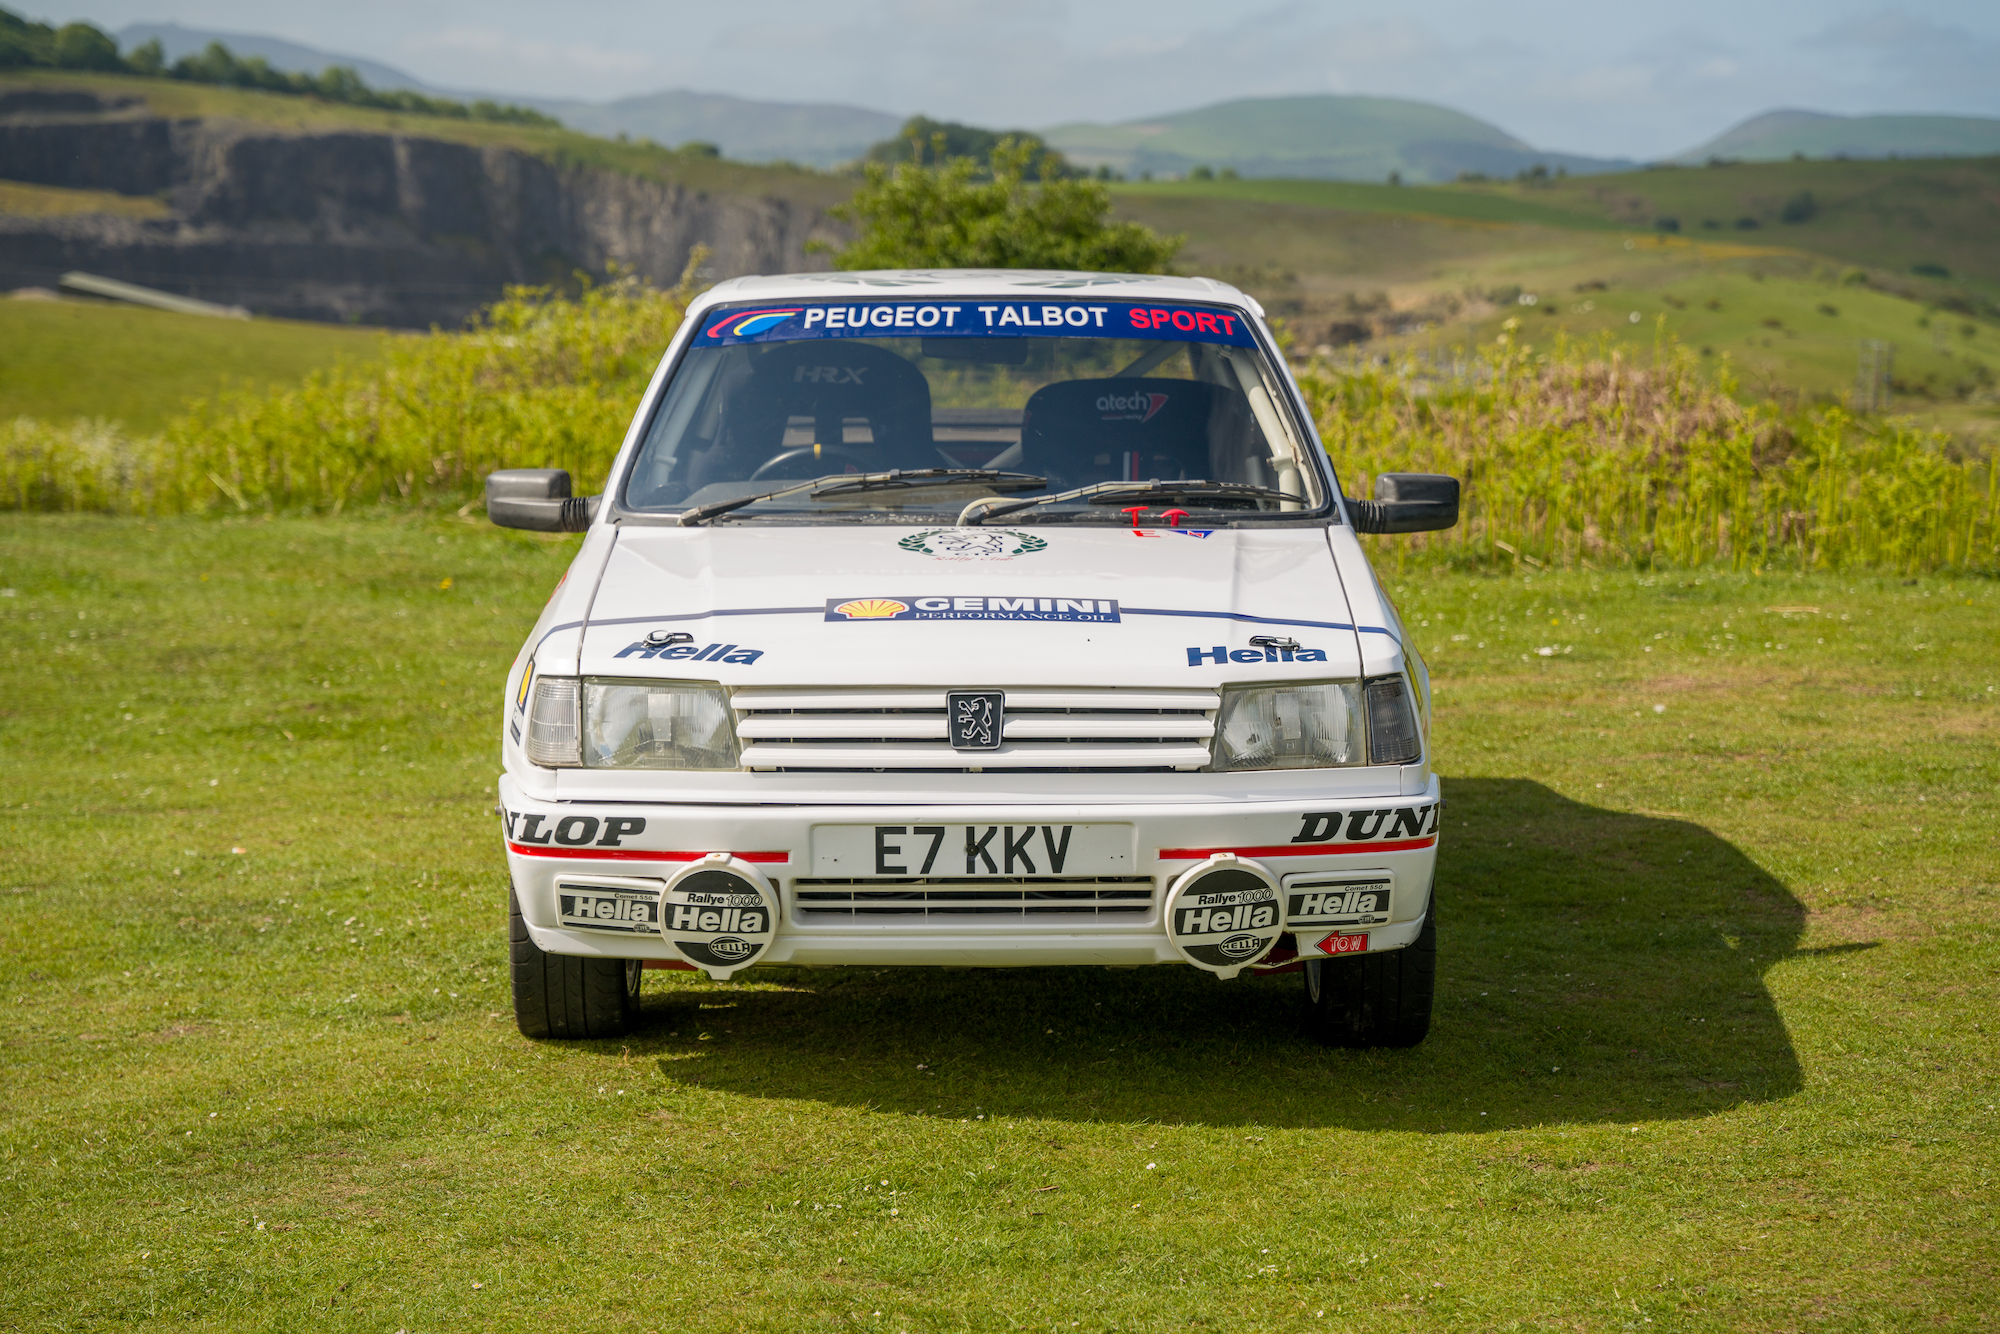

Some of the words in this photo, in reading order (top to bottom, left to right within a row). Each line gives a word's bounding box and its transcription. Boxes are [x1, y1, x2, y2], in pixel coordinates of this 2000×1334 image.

[803, 306, 962, 329] PEUGEOT
[978, 306, 1108, 327] TALBOT
[1129, 308, 1236, 336] SPORT
[793, 366, 868, 385] HRX
[1096, 391, 1147, 411] atech
[914, 597, 1111, 614] GEMINI
[915, 612, 1071, 621] PERFORMANCE
[1078, 613, 1113, 622] OIL
[613, 641, 764, 665] Hella
[1186, 645, 1328, 667] Hella
[875, 826, 945, 874] E7
[965, 825, 1073, 874] KKV
[687, 893, 725, 905] Rallye
[726, 894, 763, 907] 1000
[1198, 893, 1236, 905] Rallye
[1237, 888, 1273, 904] 1000
[1299, 892, 1378, 915] Hella
[573, 896, 650, 921] Hella
[672, 906, 763, 932] Hella
[1182, 905, 1273, 933] Hella
[712, 943, 750, 952] HELLA
[1223, 938, 1260, 949] HELLA
[1330, 936, 1362, 952] TOW
